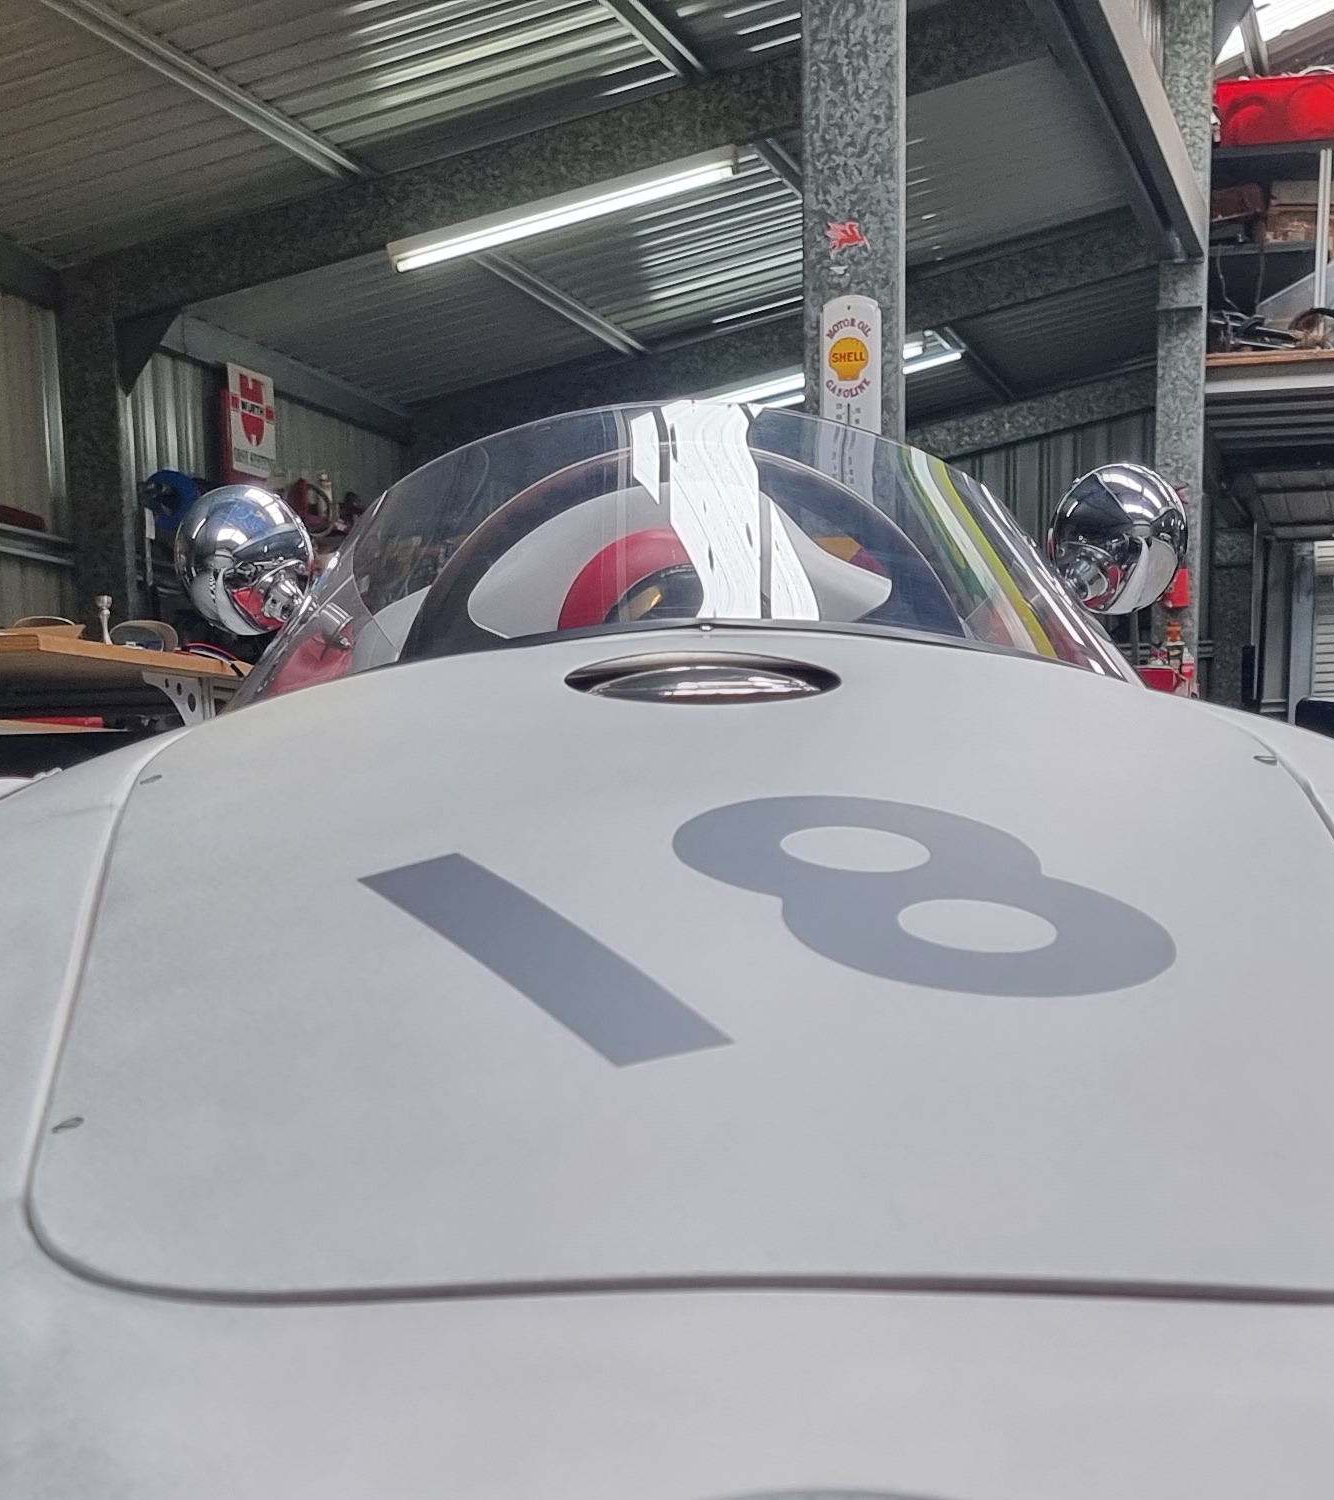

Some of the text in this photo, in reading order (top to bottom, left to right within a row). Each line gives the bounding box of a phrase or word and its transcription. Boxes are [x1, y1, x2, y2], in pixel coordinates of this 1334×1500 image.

[826, 318, 872, 339] MOTOR OIL
[831, 351, 866, 363] SHELL
[826, 378, 871, 399] GASOLINE
[357, 795, 1177, 1068] 18
